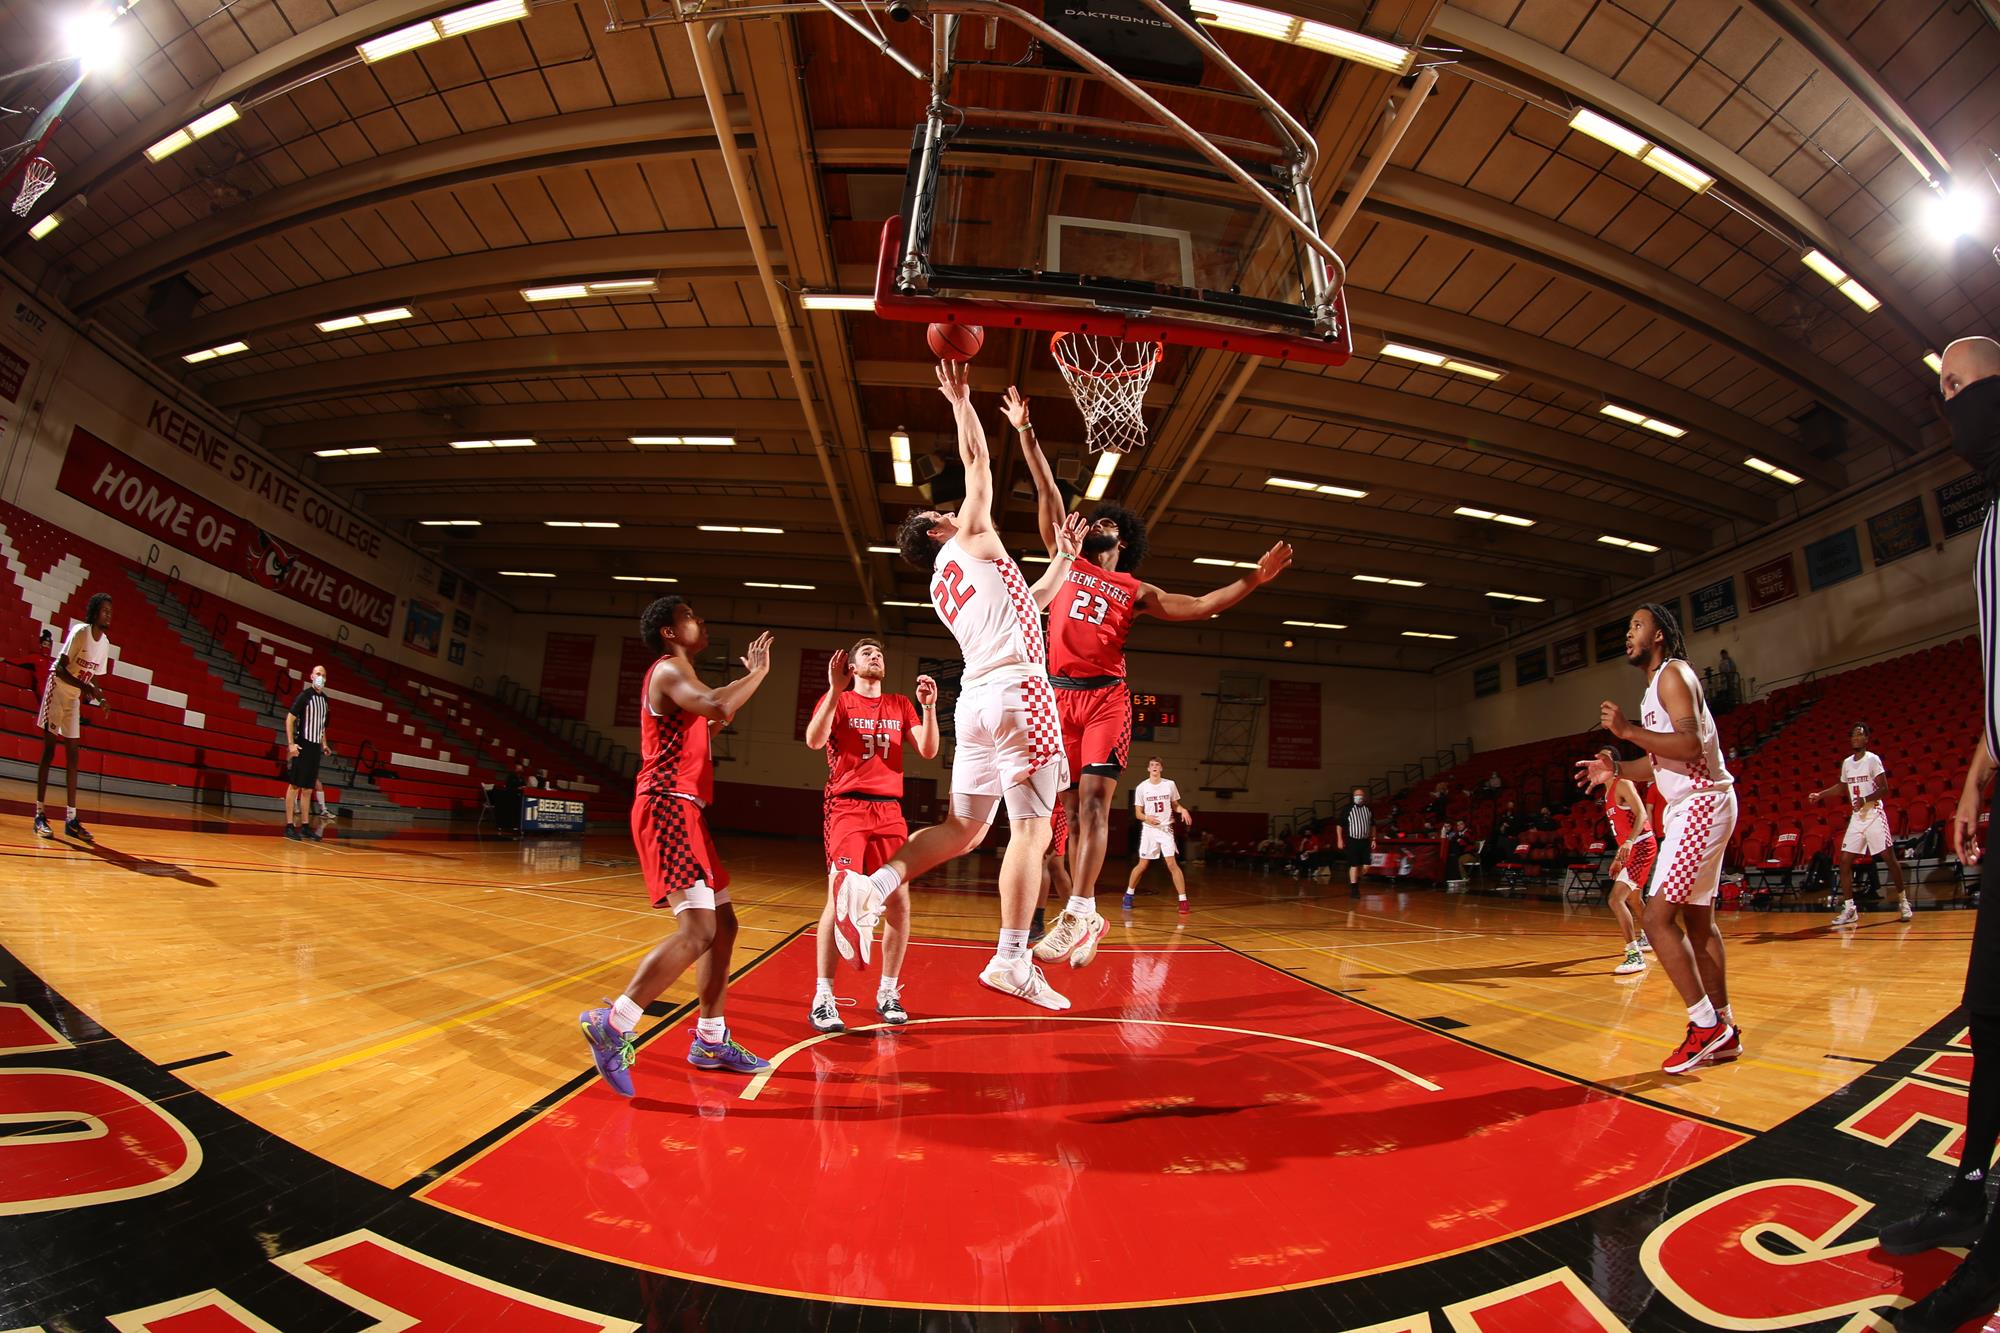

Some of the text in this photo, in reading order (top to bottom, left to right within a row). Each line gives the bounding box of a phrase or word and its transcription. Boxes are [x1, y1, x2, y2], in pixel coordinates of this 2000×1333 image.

[1064, 9, 1172, 28] DAKTRONICS
[147, 399, 381, 559] KEENE STATE COLLEGE
[91, 462, 393, 627] HOME OF THE OWLS
[1755, 568, 1783, 585] KEENE
[933, 560, 976, 625] 22
[1098, 581, 1131, 606] STATE
[1759, 582, 1785, 598] STATE
[1069, 589, 1109, 625] 23
[1703, 598, 1723, 612] EAST
[848, 718, 901, 732] KEENE STATE
[862, 733, 890, 760] 34
[538, 798, 584, 814] BEEZE TEES
[1154, 801, 1164, 813] 13
